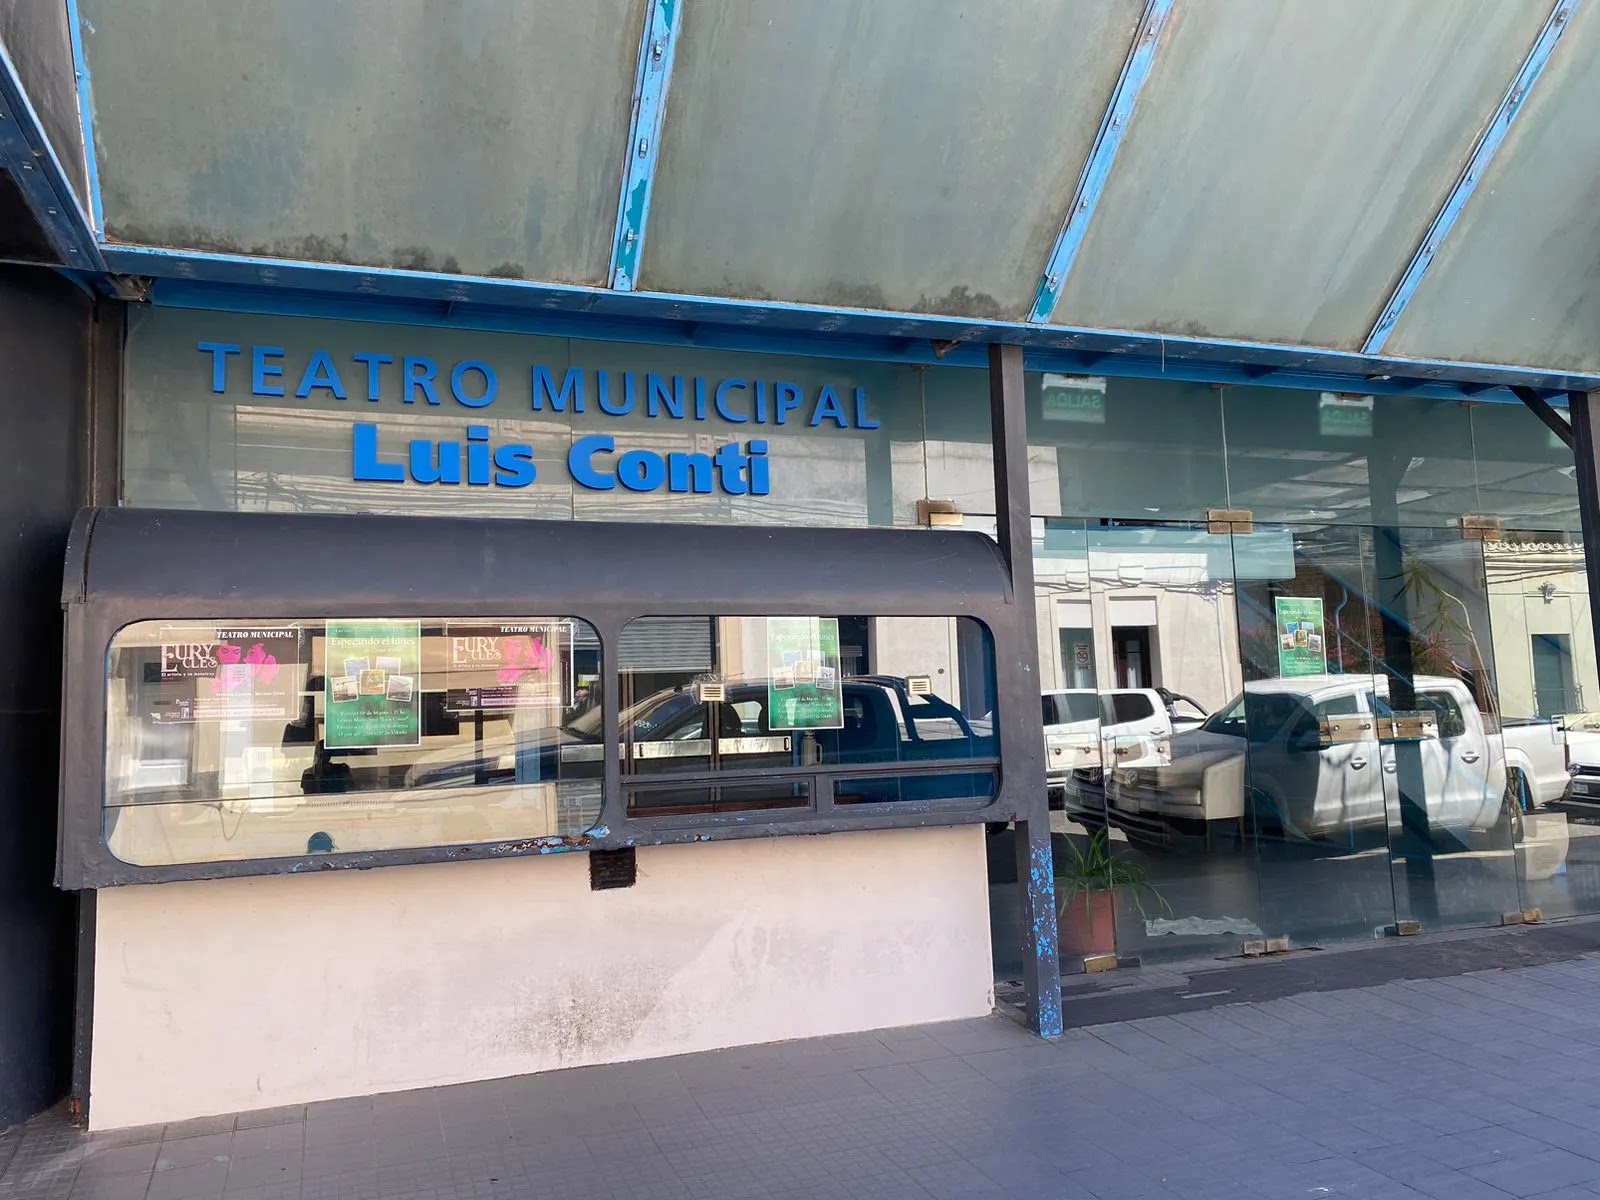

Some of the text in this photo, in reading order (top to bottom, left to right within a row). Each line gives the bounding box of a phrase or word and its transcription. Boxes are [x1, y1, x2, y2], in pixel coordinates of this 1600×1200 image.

[198, 341, 881, 430] TEATRO MUNICIPAL
[352, 423, 770, 496] Luis Conti
[217, 630, 294, 639] TEATRO MUNICIPAL
[332, 635, 380, 648] Esperando
[381, 635, 389, 646] el
